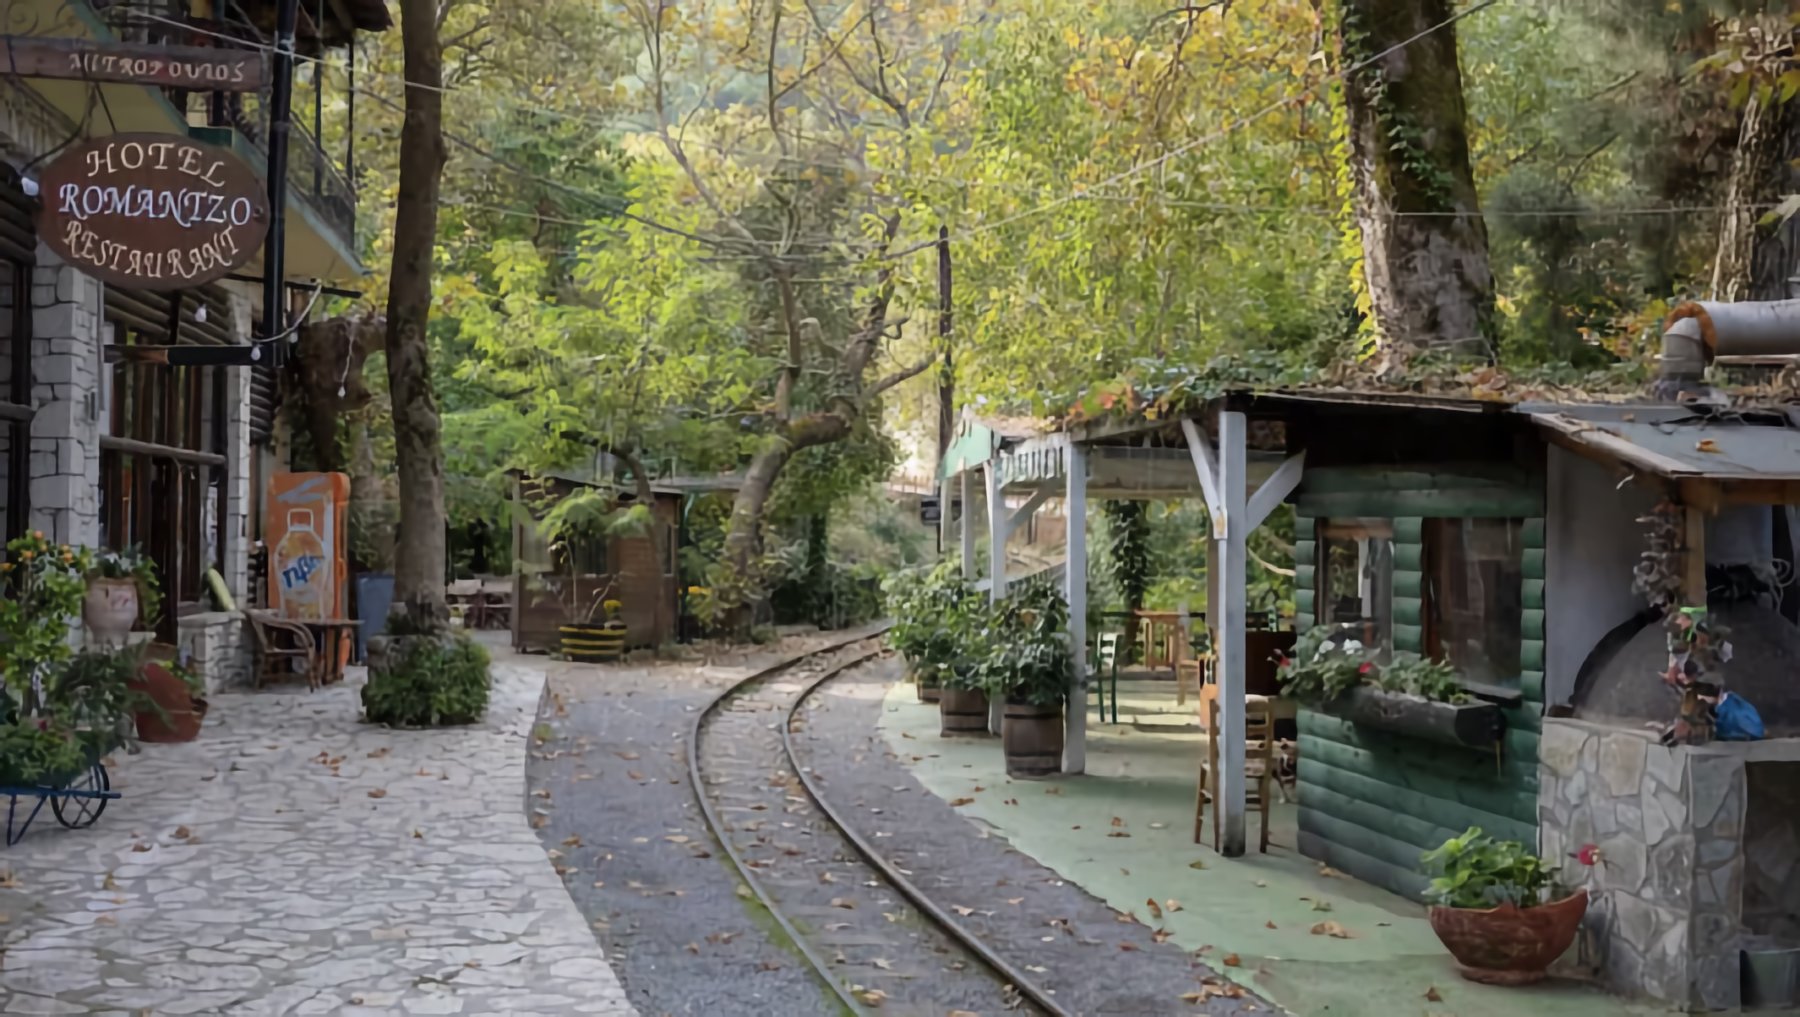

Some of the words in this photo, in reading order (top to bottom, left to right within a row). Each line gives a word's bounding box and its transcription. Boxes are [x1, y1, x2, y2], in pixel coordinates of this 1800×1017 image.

[86, 142, 226, 188] HOTEL
[58, 182, 251, 228] ROMANTZO
[61, 220, 240, 279] RESTAURANT
